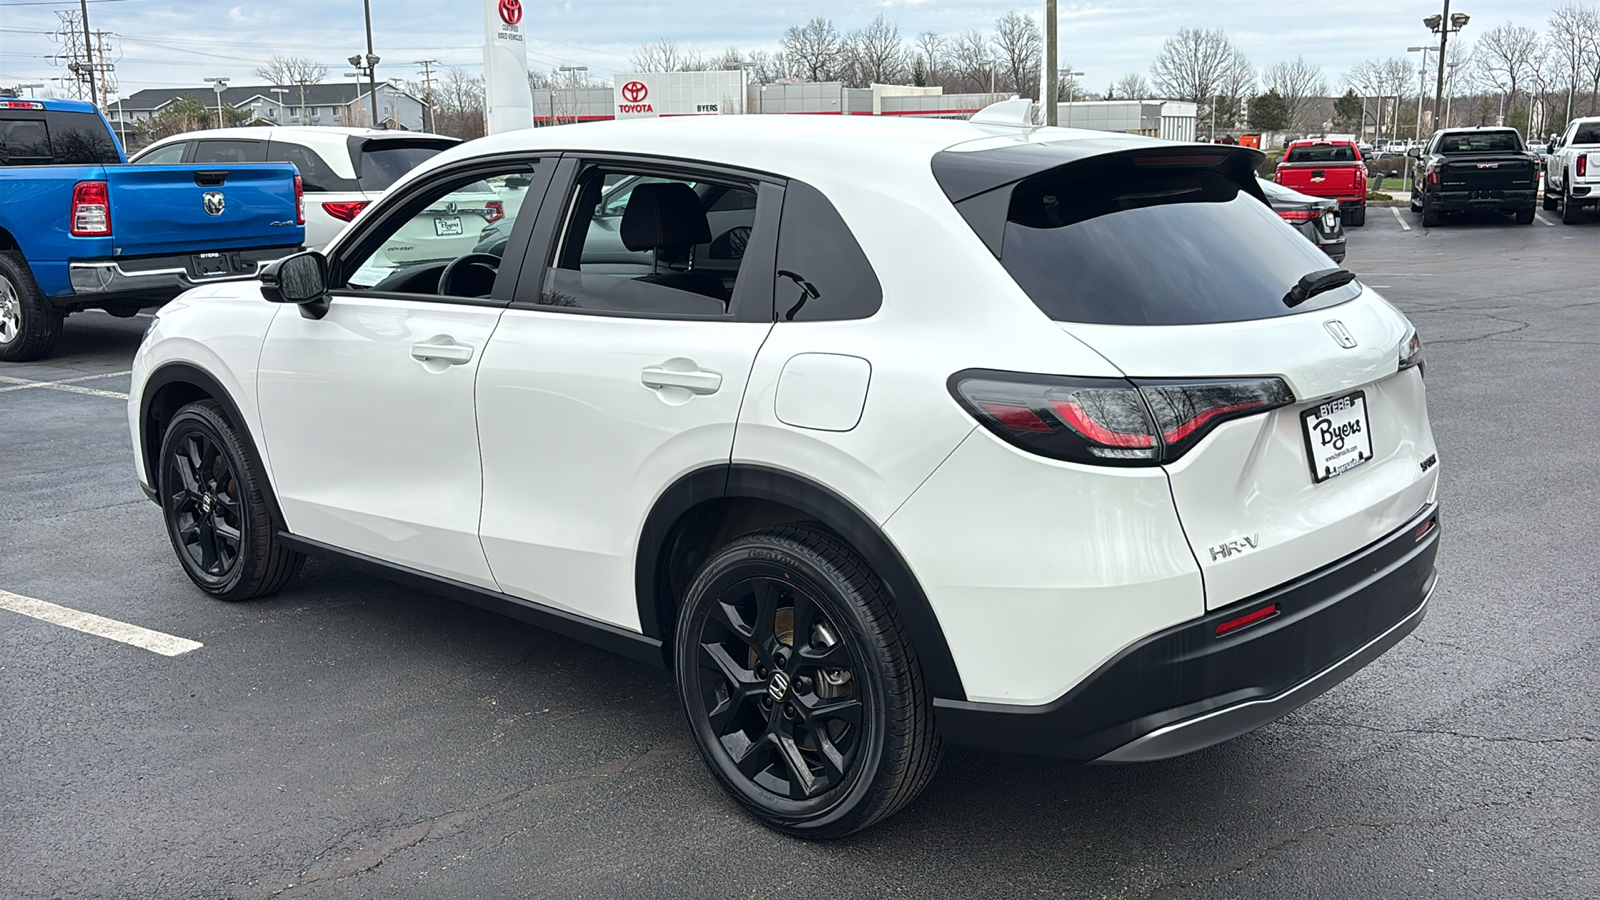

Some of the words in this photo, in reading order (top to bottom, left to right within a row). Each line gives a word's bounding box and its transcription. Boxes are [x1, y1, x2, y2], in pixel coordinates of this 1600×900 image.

[619, 104, 653, 113] TOYOTA
[697, 104, 718, 112] BYERS
[1320, 397, 1351, 417] BYERS
[1312, 418, 1362, 450] Byers
[1209, 532, 1259, 561] HR-V
